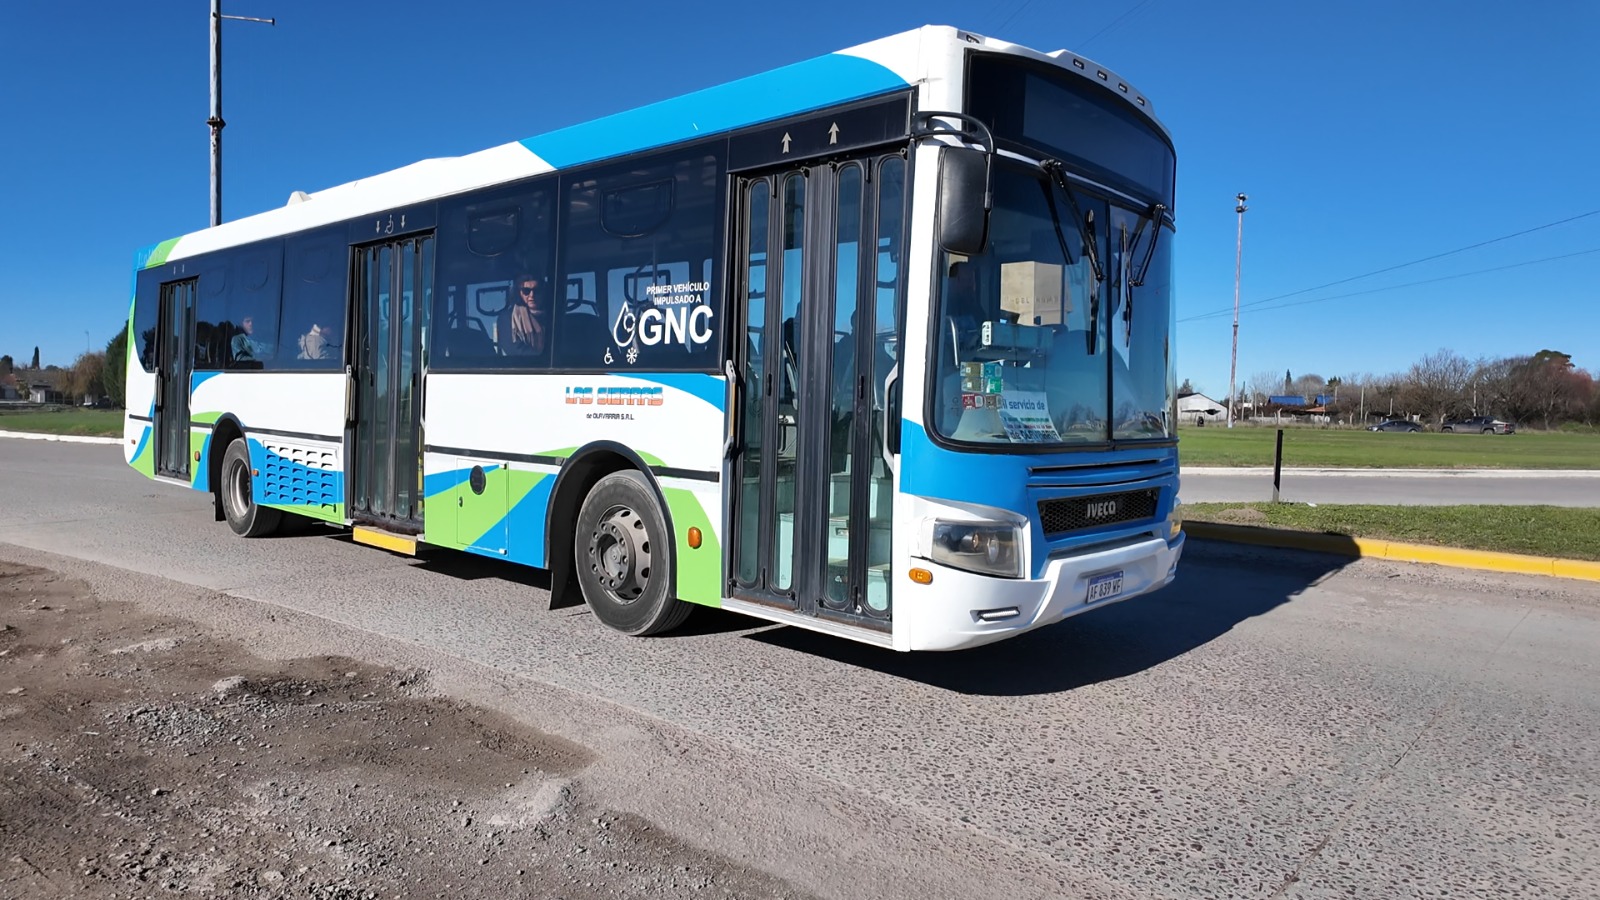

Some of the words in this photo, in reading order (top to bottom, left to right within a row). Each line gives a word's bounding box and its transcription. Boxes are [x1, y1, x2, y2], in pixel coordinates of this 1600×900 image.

[646, 285, 672, 295] PRIMER
[673, 281, 710, 293] VEHÍCULO
[654, 295, 695, 305] IMPULSADO
[696, 294, 702, 303] A
[638, 304, 714, 346] GNC
[565, 386, 594, 404] LAS
[597, 387, 664, 406] SIERRAS
[1009, 399, 1036, 410] servicio
[1036, 400, 1046, 410] de
[1086, 501, 1117, 518] IVECO
[1089, 585, 1098, 600] AF
[1099, 581, 1112, 597] 839
[1112, 579, 1121, 593] WF
